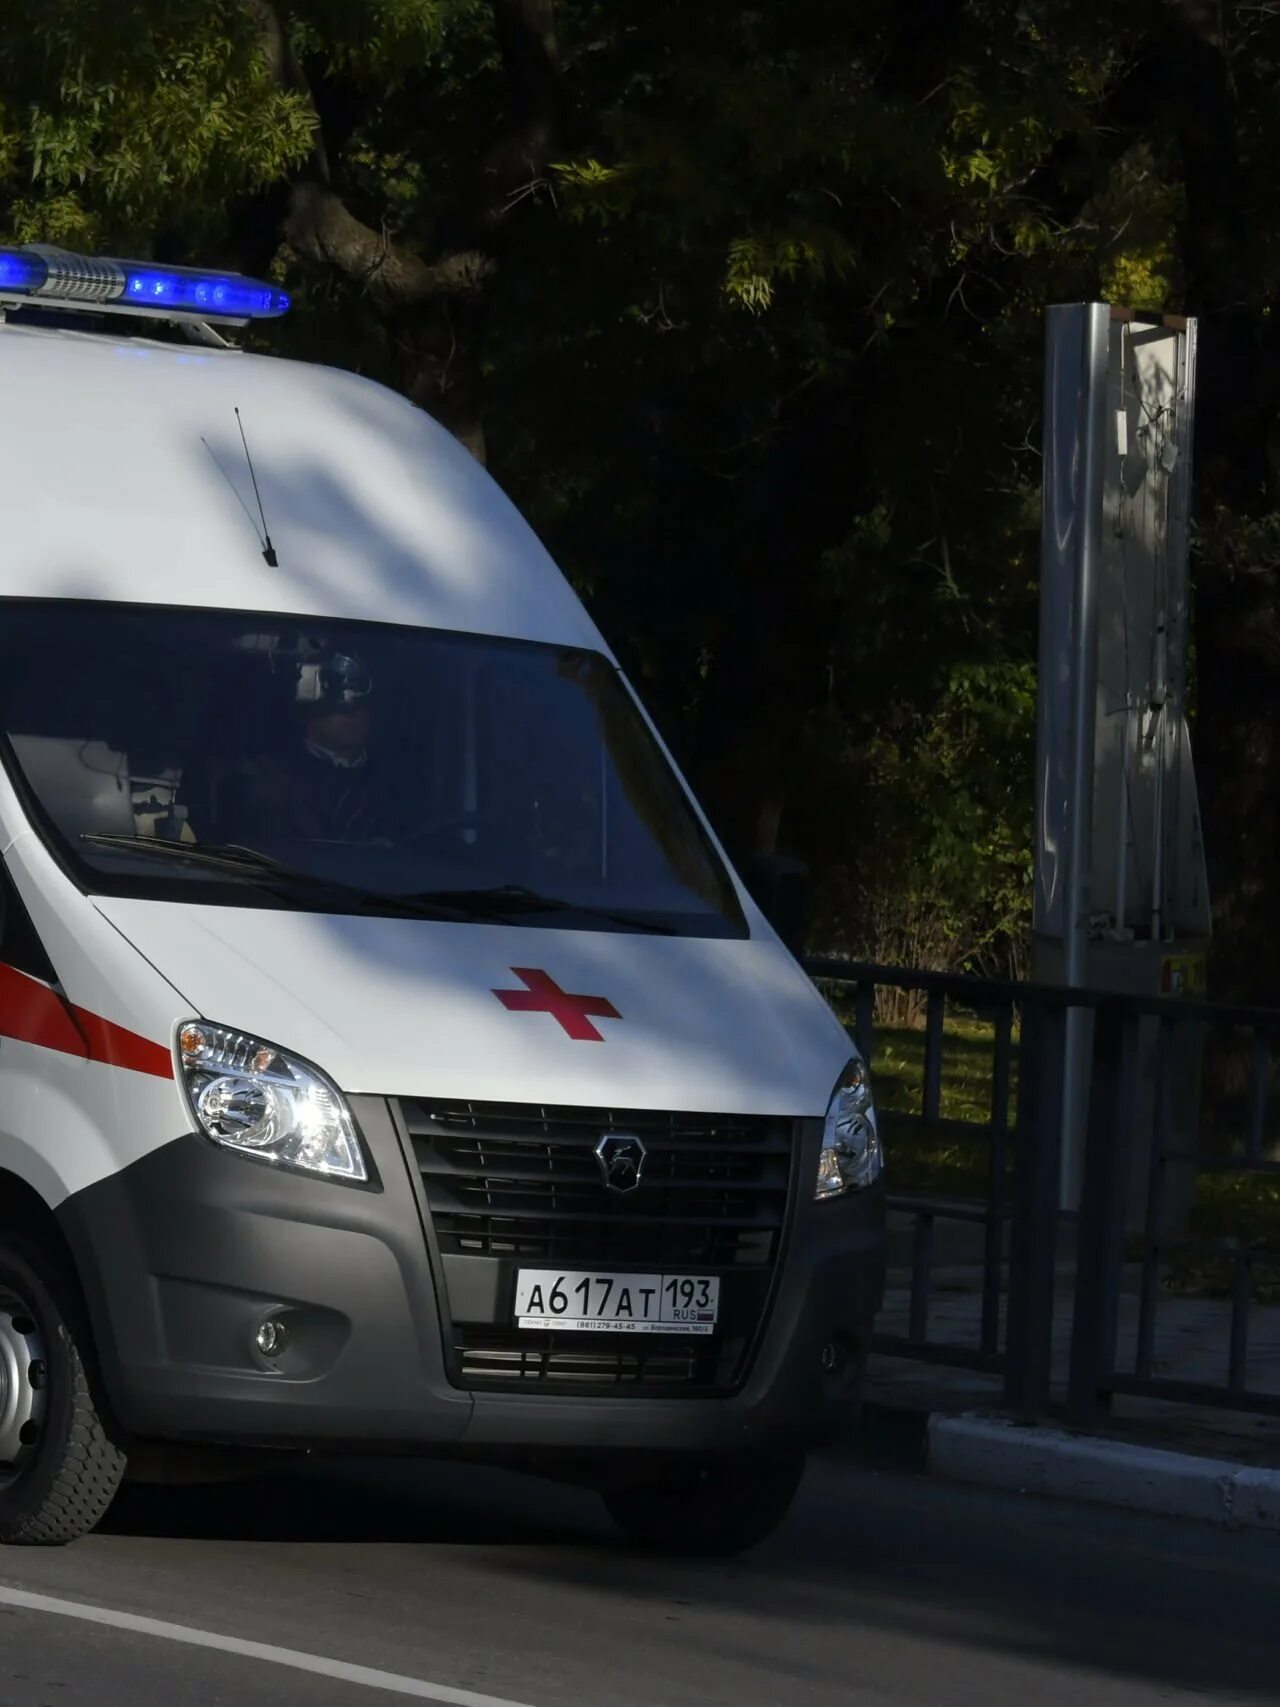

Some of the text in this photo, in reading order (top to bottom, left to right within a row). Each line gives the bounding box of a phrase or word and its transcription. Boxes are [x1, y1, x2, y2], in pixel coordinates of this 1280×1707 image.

[526, 1276, 710, 1318] А617АТ 193
[673, 1309, 697, 1321] RUS
